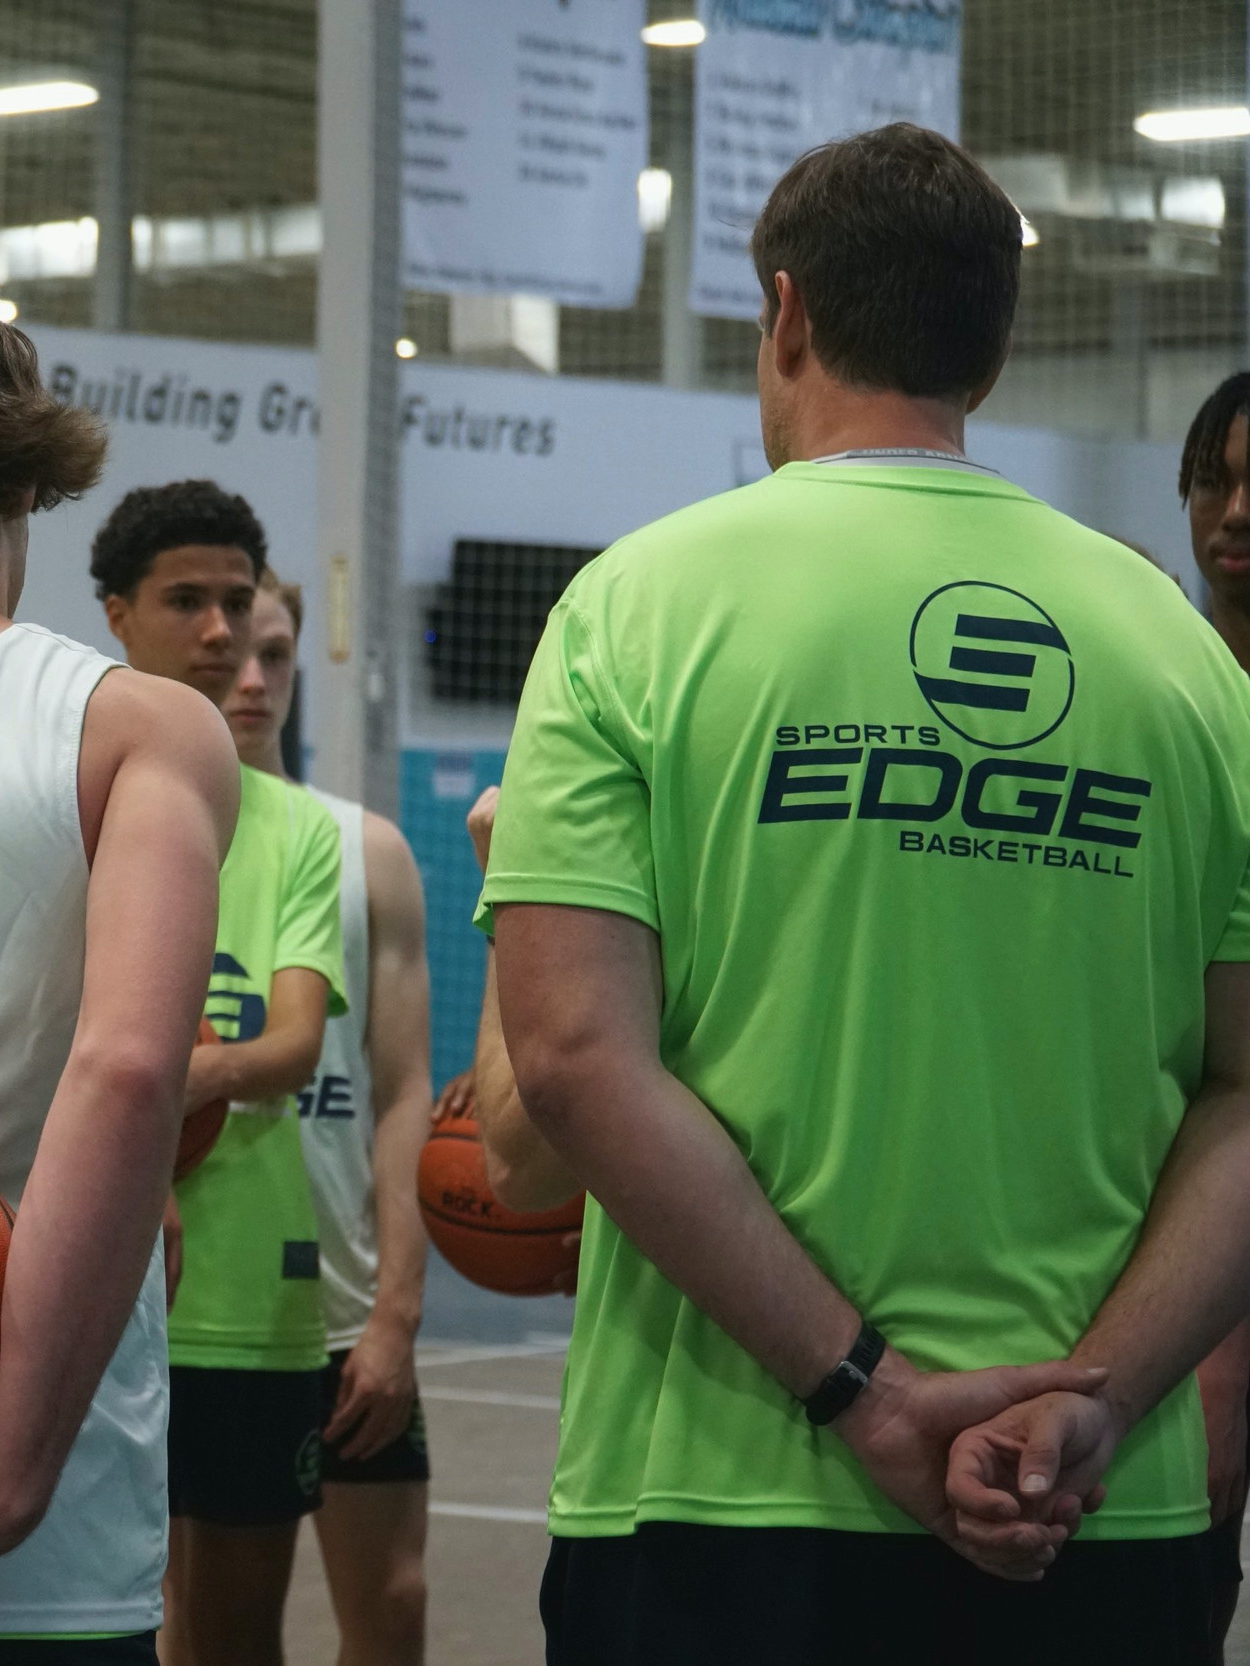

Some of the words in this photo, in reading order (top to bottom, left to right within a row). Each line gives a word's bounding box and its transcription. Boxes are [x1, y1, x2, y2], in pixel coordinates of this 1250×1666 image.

[49, 364, 242, 444] Building
[401, 396, 558, 457] Futures
[775, 724, 940, 747] SPORTS
[757, 747, 1152, 849] EDGE
[899, 831, 1134, 878] BASKETBALL
